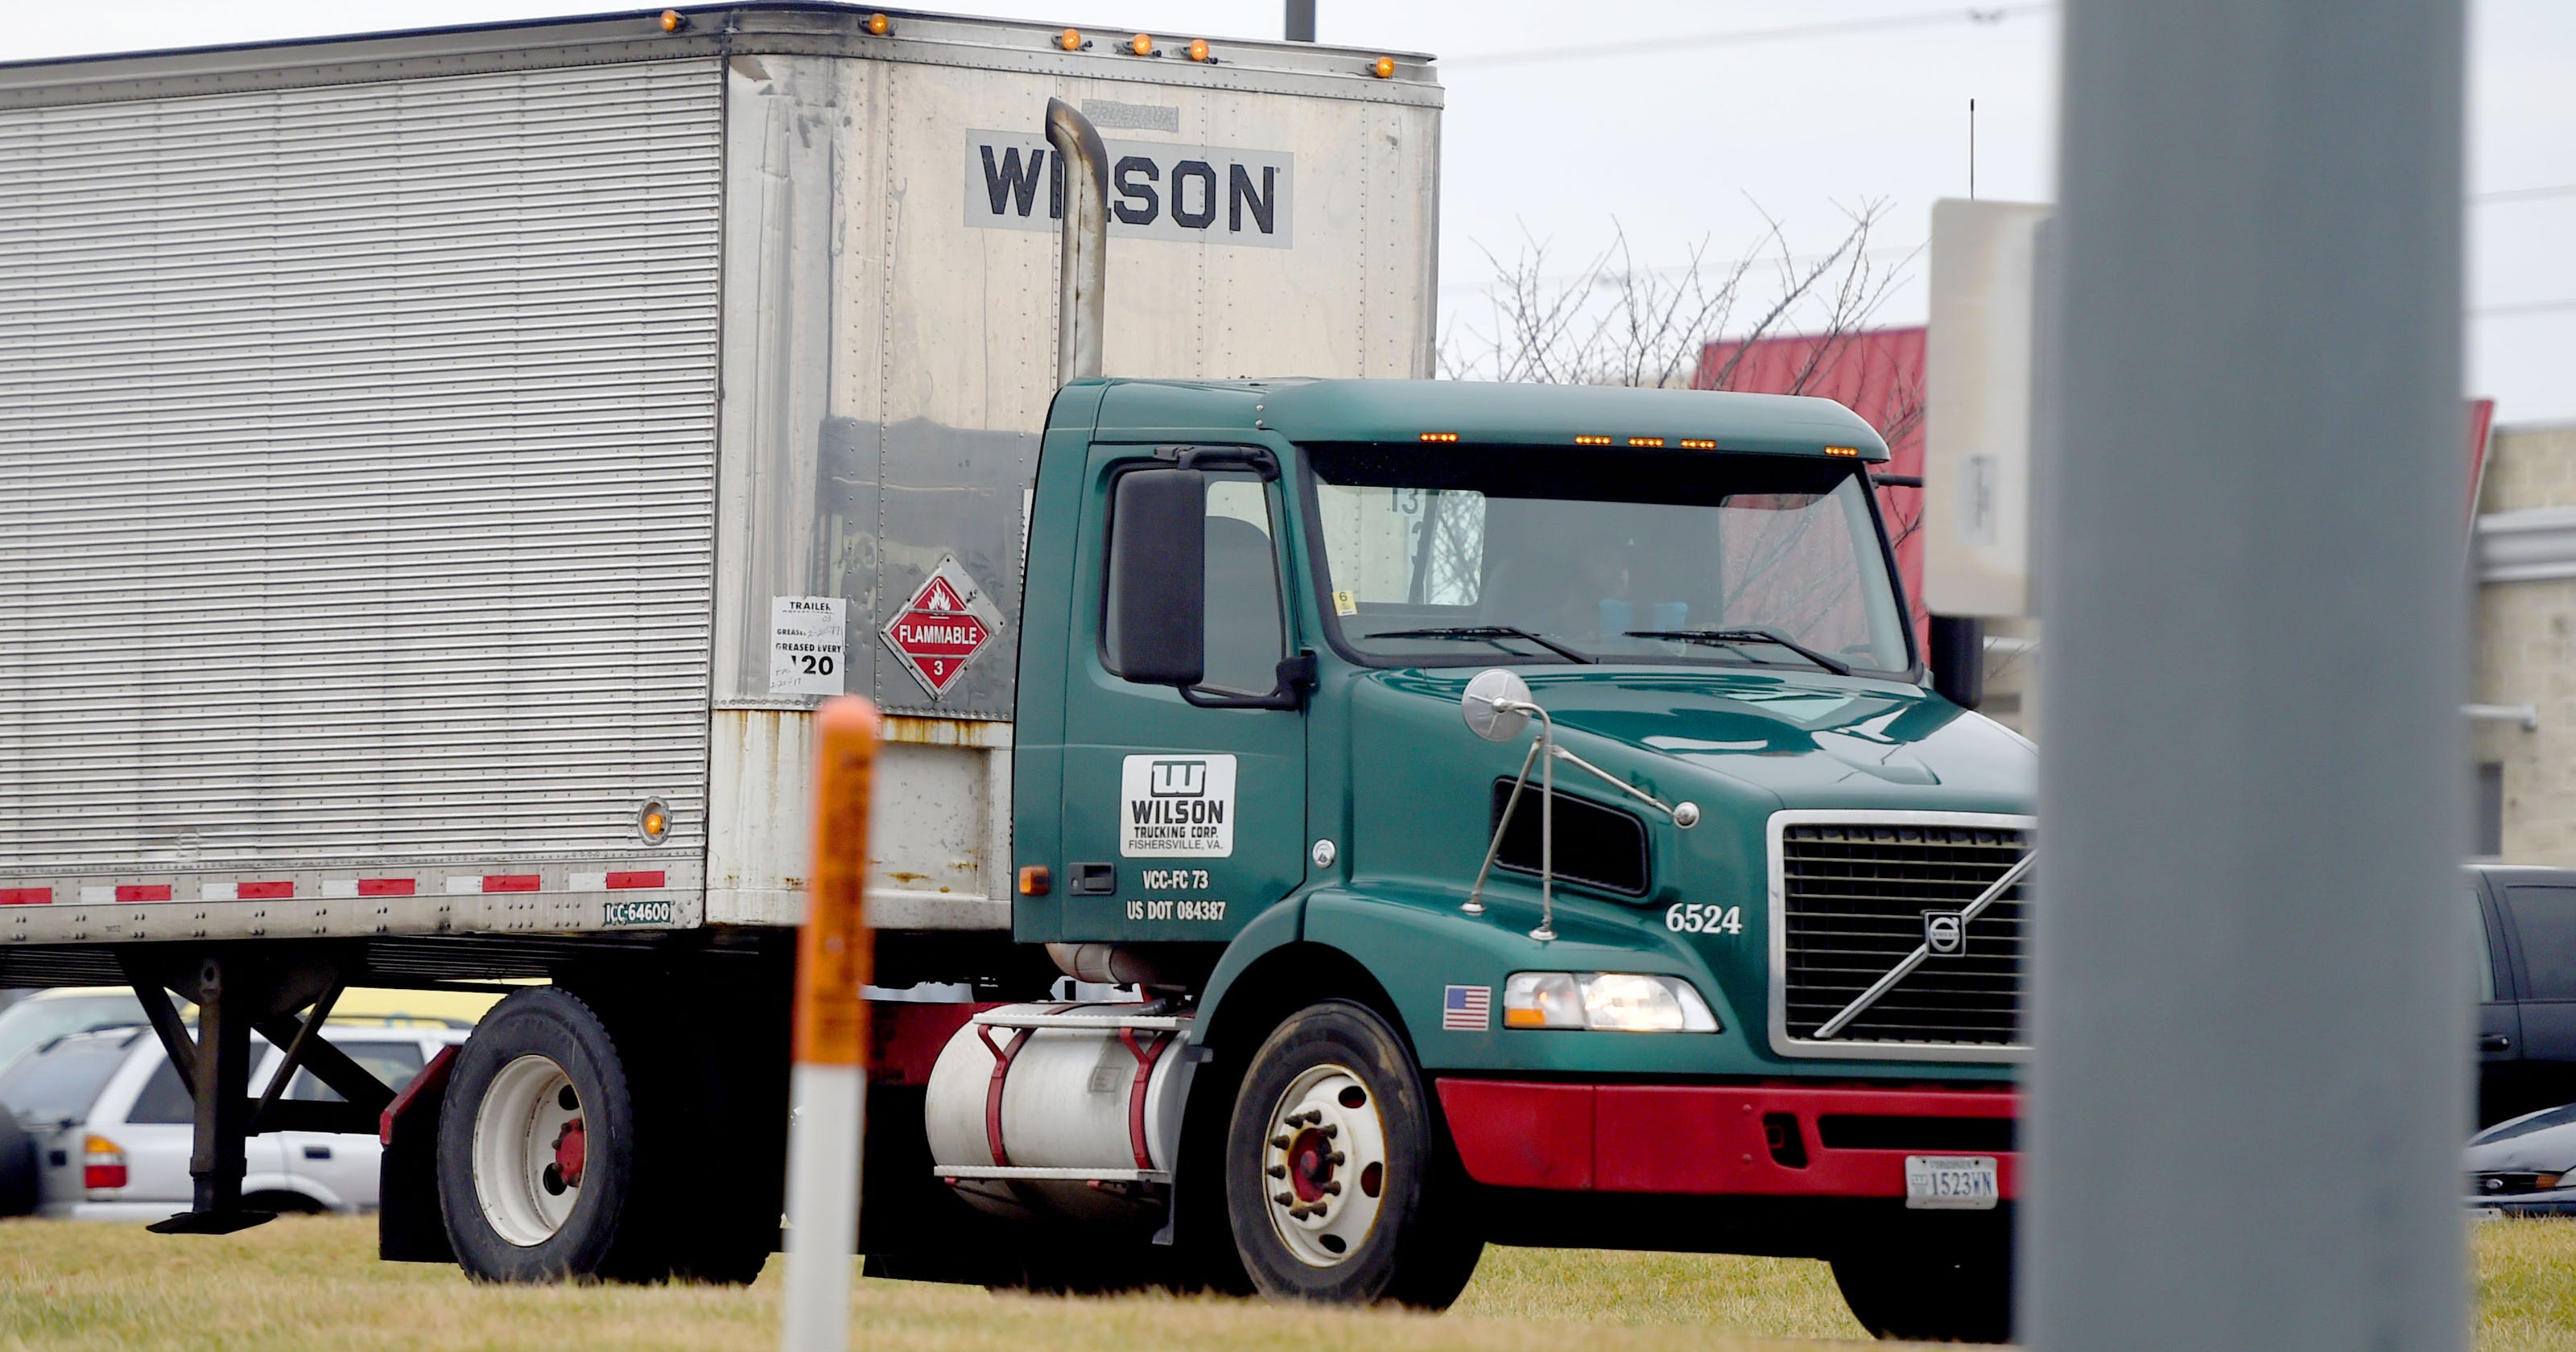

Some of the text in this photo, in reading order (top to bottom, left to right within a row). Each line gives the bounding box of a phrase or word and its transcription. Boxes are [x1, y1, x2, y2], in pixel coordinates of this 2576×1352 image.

[980, 145, 1274, 234] WISON
[1340, 592, 1348, 602] 6
[899, 624, 977, 645] FLAMMABLE
[775, 643, 815, 652] GREASED
[934, 660, 943, 676] 3
[1131, 800, 1224, 824] WILSON
[1134, 826, 1218, 839] TRUCKING CORP.
[1129, 839, 1224, 851] FISHERSVILLE, VA.
[1142, 870, 1209, 889] VCC-FC 73
[606, 902, 670, 922] ICC-64600
[1127, 901, 1226, 921] US DOT 084387
[1666, 902, 1743, 934] 6524
